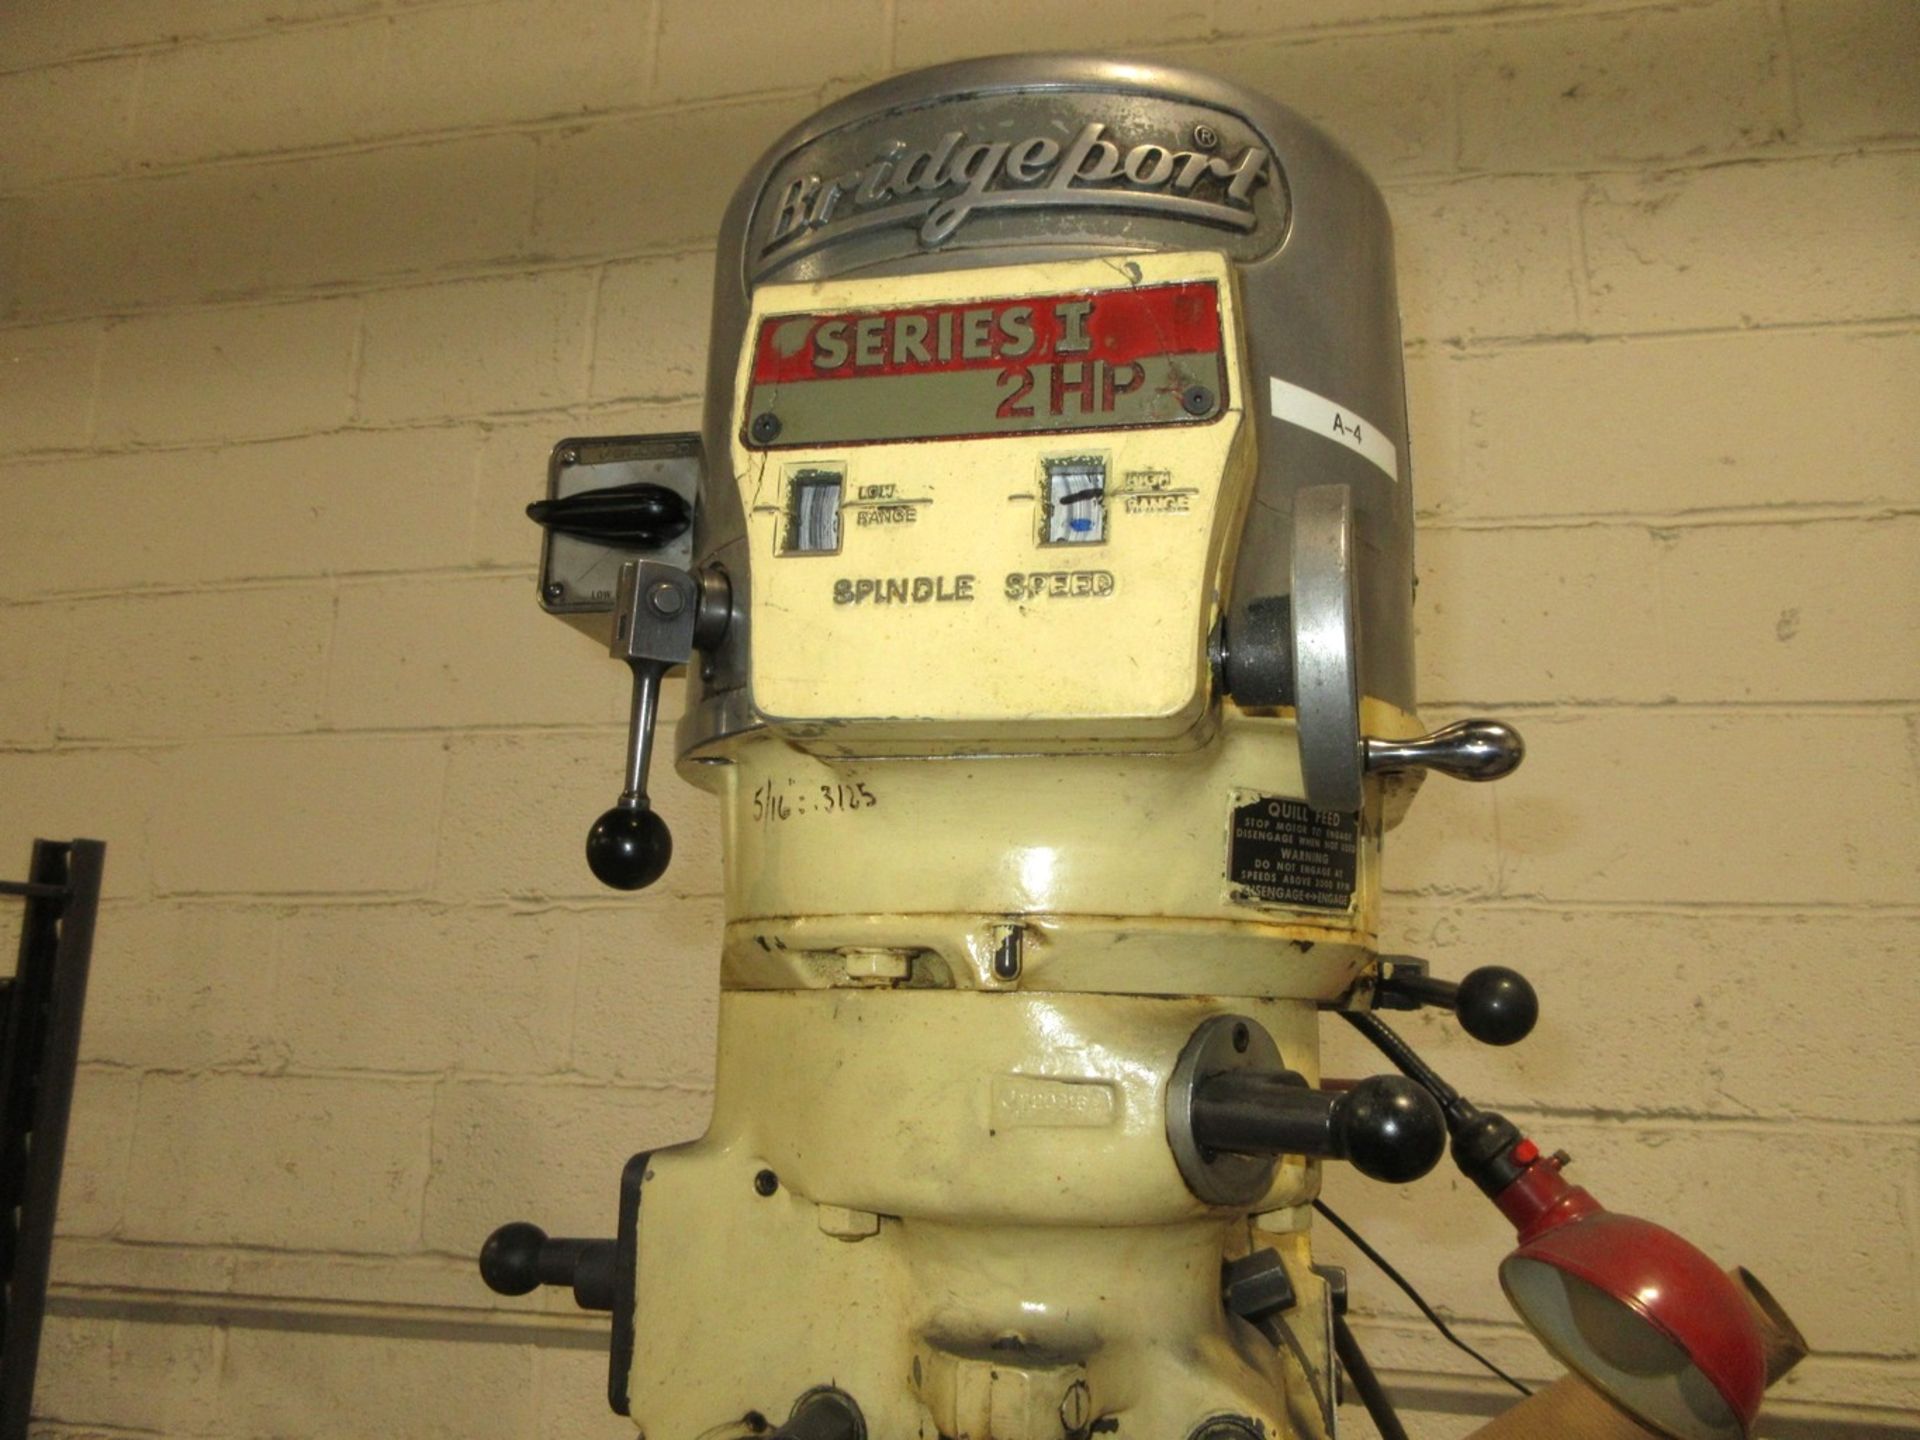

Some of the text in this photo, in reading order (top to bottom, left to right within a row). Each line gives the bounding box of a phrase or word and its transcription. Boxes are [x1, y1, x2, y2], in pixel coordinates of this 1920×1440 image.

[762, 122, 1270, 252] Bridgeport
[813, 305, 1034, 370] SERIES
[1333, 411, 1363, 444] A-4
[1125, 470, 1171, 491] HIGH
[858, 484, 896, 500] LOW
[1125, 495, 1190, 514] RANGE
[857, 507, 917, 526] RANGE
[833, 570, 1115, 605] SPINDLE SPEED
[1268, 801, 1341, 827] QUILL FEED
[1244, 817, 1270, 829] STOP
[1276, 820, 1308, 834] MOTOR
[1236, 828, 1294, 844] DISENGAGE
[1298, 836, 1321, 848] WHEN
[1281, 847, 1329, 864] WARNING
[1241, 869, 1277, 883] SPEEDS
[1283, 875, 1312, 887] ABOVE
[1254, 859, 1344, 879] DO NOT ENGAGE AT
[1316, 891, 1349, 906] ENGAGE
